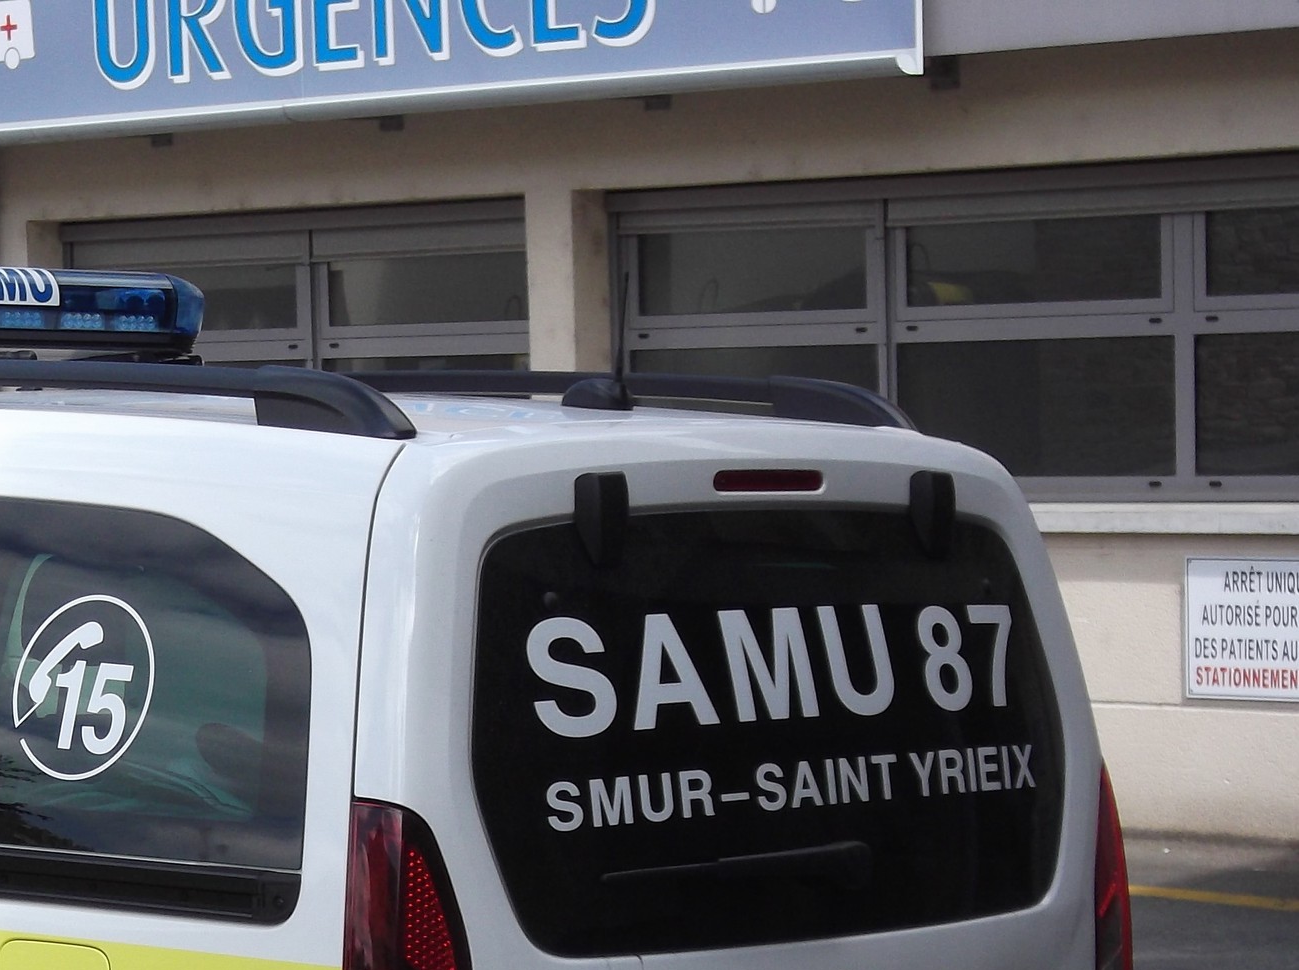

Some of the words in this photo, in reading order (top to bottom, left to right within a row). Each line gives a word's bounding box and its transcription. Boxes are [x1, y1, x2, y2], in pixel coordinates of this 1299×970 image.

[1223, 565, 1263, 593] ARRÊT
[1202, 600, 1261, 627] AUTORISÉ
[1264, 605, 1299, 628] POUR
[1194, 637, 1218, 659] DES
[1221, 638, 1278, 661] PATIENTS
[526, 604, 895, 738] SAMU
[917, 604, 1012, 711] 87
[55, 659, 134, 755] 15
[908, 744, 1037, 797] YRIEIX
